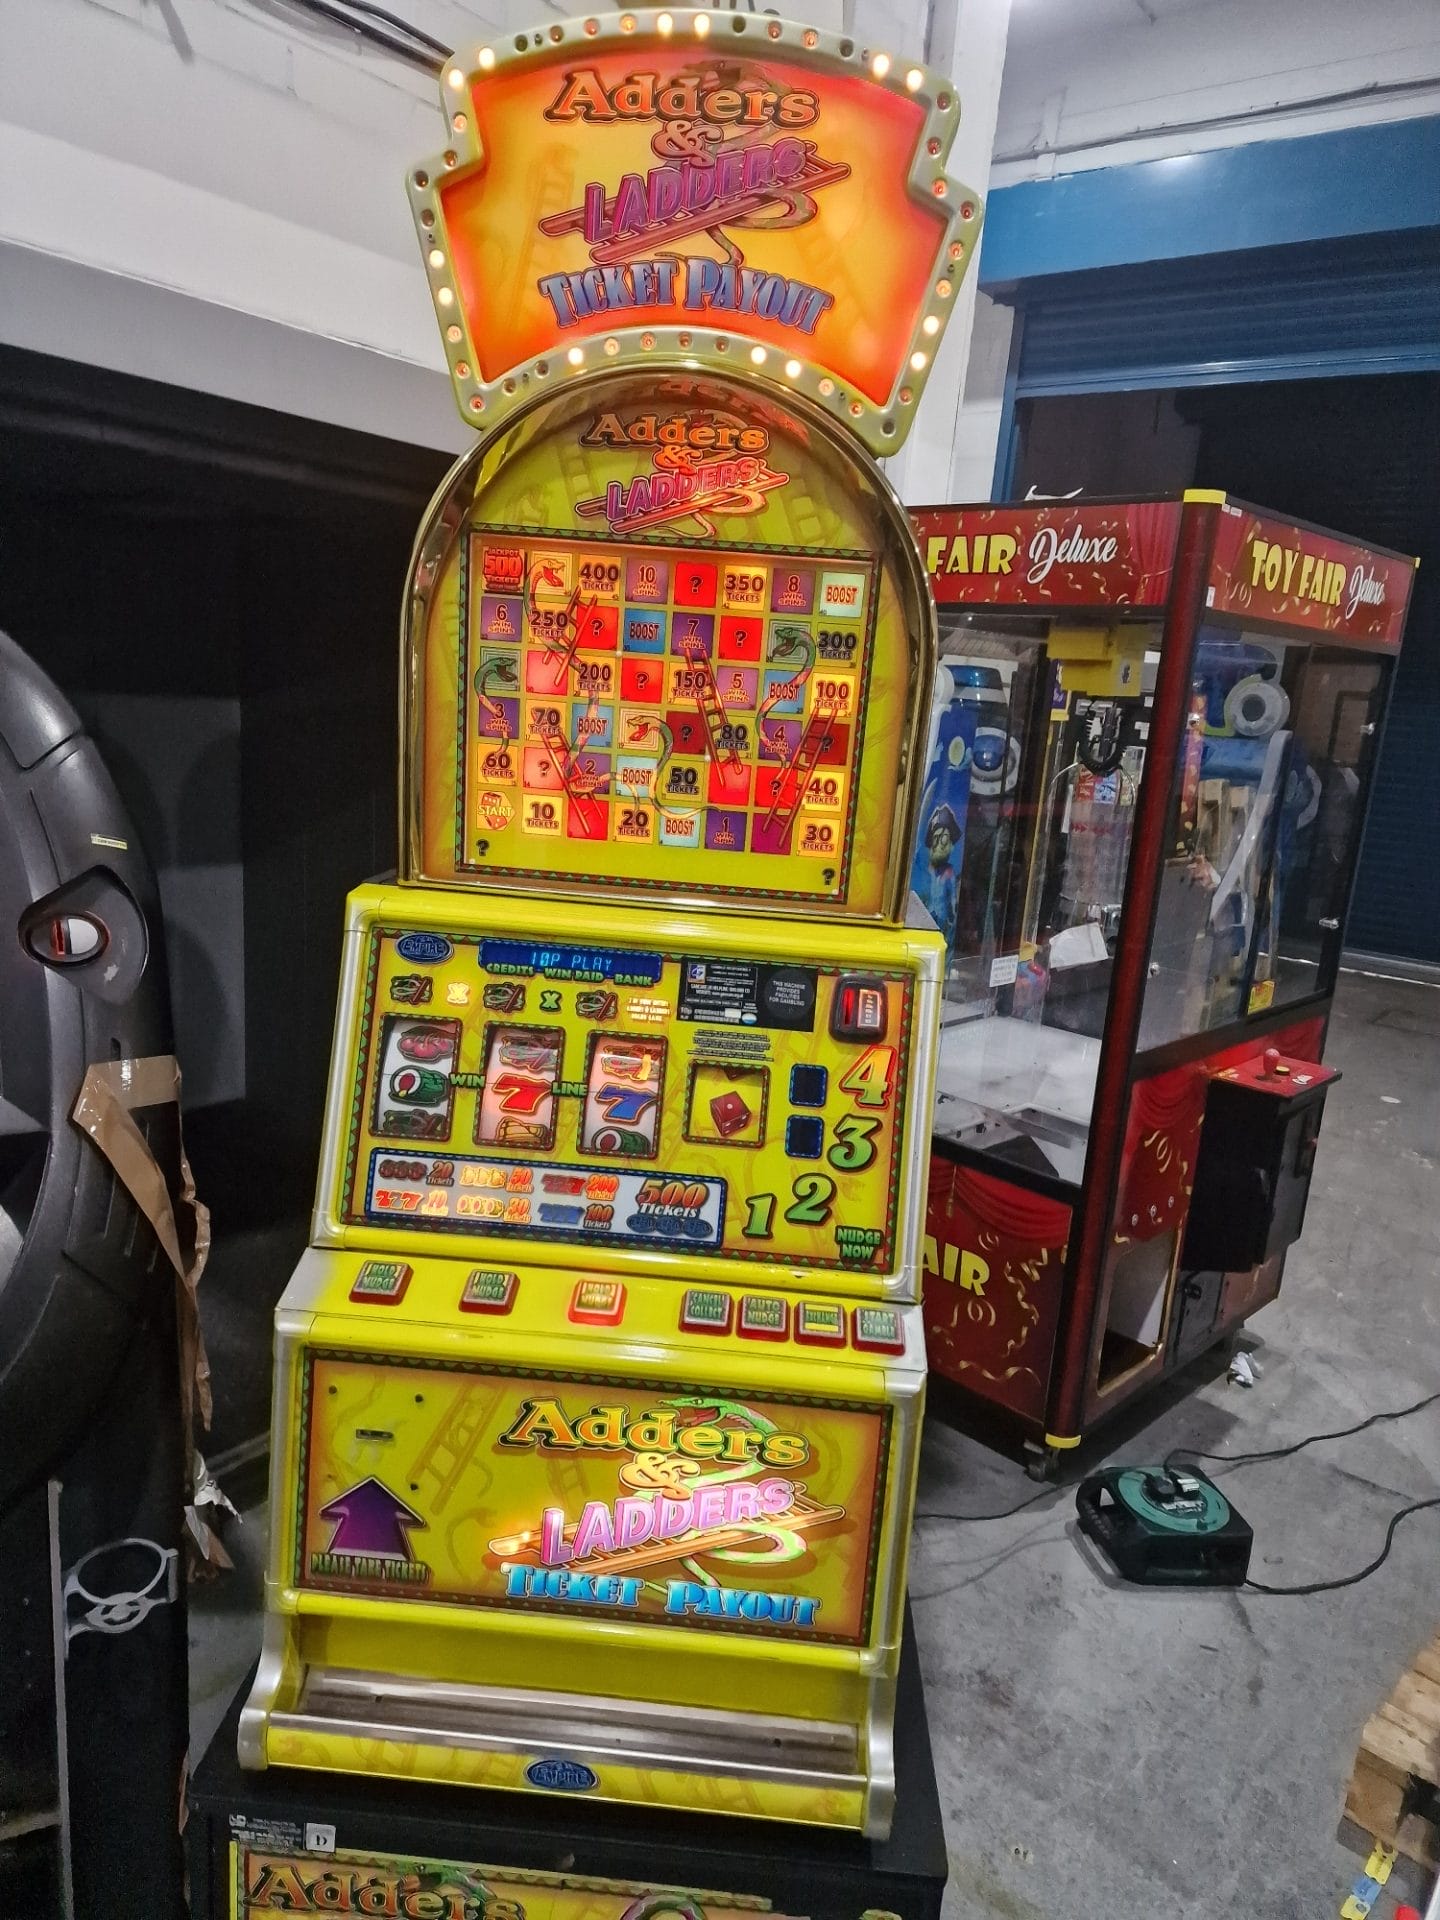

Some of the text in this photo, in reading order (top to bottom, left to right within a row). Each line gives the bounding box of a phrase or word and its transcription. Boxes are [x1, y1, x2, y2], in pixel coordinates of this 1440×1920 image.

[544, 70, 820, 128] Adders
[652, 119, 724, 167] &
[584, 138, 808, 244] LADDERS
[538, 257, 834, 334] TICKET PAYOUT
[579, 413, 769, 454] Adders
[654, 444, 702, 475] &
[607, 457, 761, 521] LADDERS
[927, 524, 1117, 584] FAIR Deluxe
[484, 555, 523, 577] 500
[580, 563, 619, 581] 400
[639, 566, 656, 583] 10
[582, 581, 614, 592] TICKETS
[725, 574, 764, 592] 350
[788, 575, 799, 592] 8
[1252, 539, 1386, 619] TOY FAIR Deluxe
[726, 592, 760, 602] TICKETS
[826, 585, 858, 605] BOOST
[496, 604, 507, 620] 6
[530, 611, 568, 627] 250
[532, 627, 565, 637] TICKETS
[629, 623, 660, 640] BOOST
[688, 618, 700, 636] 7
[817, 631, 857, 650] 300
[819, 650, 852, 660] TICKETS
[579, 663, 611, 680] 200
[674, 671, 707, 689] 150
[578, 681, 611, 692] TICKETS
[732, 673, 743, 689] 5
[817, 680, 850, 699] 100
[673, 689, 706, 699] TICKETS
[769, 682, 799, 700] BOOST
[495, 703, 505, 718] 3
[815, 700, 848, 710] TICKETS
[535, 707, 561, 725] 70
[529, 725, 561, 735] TICKETS
[578, 717, 607, 735] BOOST
[721, 724, 747, 741] 80
[774, 726, 785, 740] 4
[717, 740, 749, 751] TICKETS
[485, 752, 511, 769] 60
[585, 759, 596, 775] 2
[482, 768, 515, 778] TICKETS
[622, 768, 652, 785] BOOST
[670, 765, 698, 784] 50
[666, 784, 698, 794] TICKETS
[809, 778, 837, 795] 40
[805, 795, 839, 805] TICKETS
[478, 805, 513, 818] START
[531, 802, 555, 820] 10
[622, 809, 649, 827] 20
[526, 820, 560, 829] TICKETS
[617, 826, 649, 837] TICKETS
[664, 818, 695, 836] BOOST
[721, 817, 730, 832] 1
[806, 825, 833, 842] 30
[802, 842, 835, 851] TICKETS
[486, 963, 534, 975] CREDITS
[572, 954, 612, 971] PLAY
[544, 967, 604, 982] WIN PAID
[614, 974, 653, 987] BANK
[450, 1073, 589, 1098] WIN LINE
[839, 1045, 897, 1109] 4
[491, 1072, 554, 1116] 7
[594, 1082, 657, 1125] 7
[827, 1113, 883, 1173] 3
[432, 1159, 454, 1178] 20
[586, 1174, 619, 1192] 200
[636, 1178, 710, 1209] 500
[784, 1172, 836, 1226] 2
[587, 1204, 614, 1221] 100
[640, 1203, 698, 1218] Tickets
[742, 1193, 777, 1239] 1
[836, 1226, 883, 1244] NUDGE
[840, 1243, 876, 1263] NOW
[370, 1263, 396, 1275] HOLD
[362, 1275, 394, 1289] NUDGE
[479, 1272, 505, 1285] HOLD
[472, 1284, 504, 1299] NUDGE
[749, 1299, 780, 1311] AUTO
[748, 1311, 779, 1324] NUDGE
[498, 1396, 809, 1467] Adders
[618, 1453, 699, 1499] &
[541, 1477, 796, 1566] LADDERS
[311, 1553, 352, 1575] PLEASE
[501, 1562, 822, 1627] TICKET PAYOUT
[246, 1864, 527, 1920] Adders
